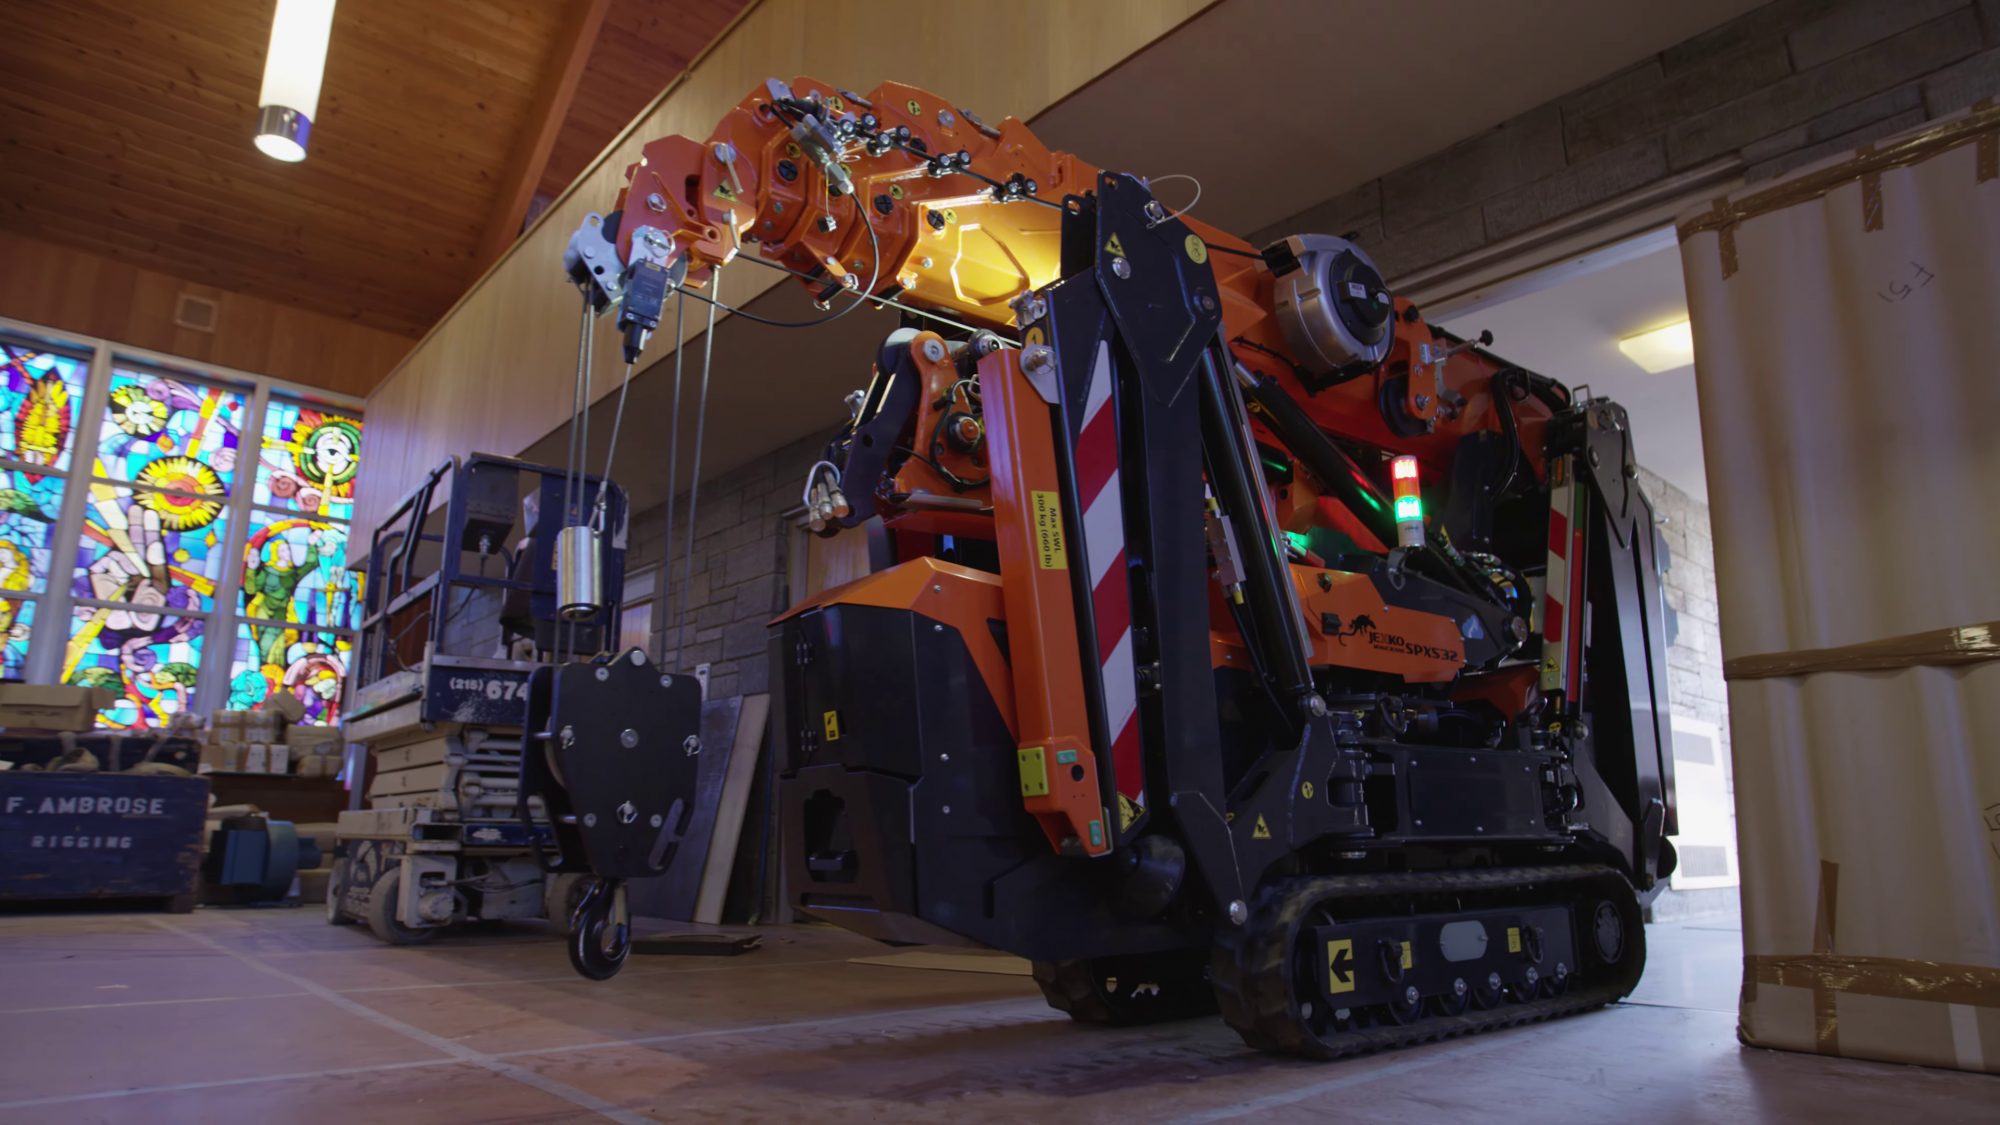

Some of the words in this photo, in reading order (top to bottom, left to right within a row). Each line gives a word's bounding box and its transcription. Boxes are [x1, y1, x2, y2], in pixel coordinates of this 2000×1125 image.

[1037, 494, 1046, 512] 300
[1039, 514, 1047, 527] kg
[1049, 508, 1057, 529] Max
[1053, 531, 1062, 553] SWL
[1041, 529, 1051, 551] (660
[1044, 553, 1052, 568] lb)
[449, 677, 484, 692] (215)
[486, 679, 529, 701] 674
[31, 835, 133, 849] RIGGING
